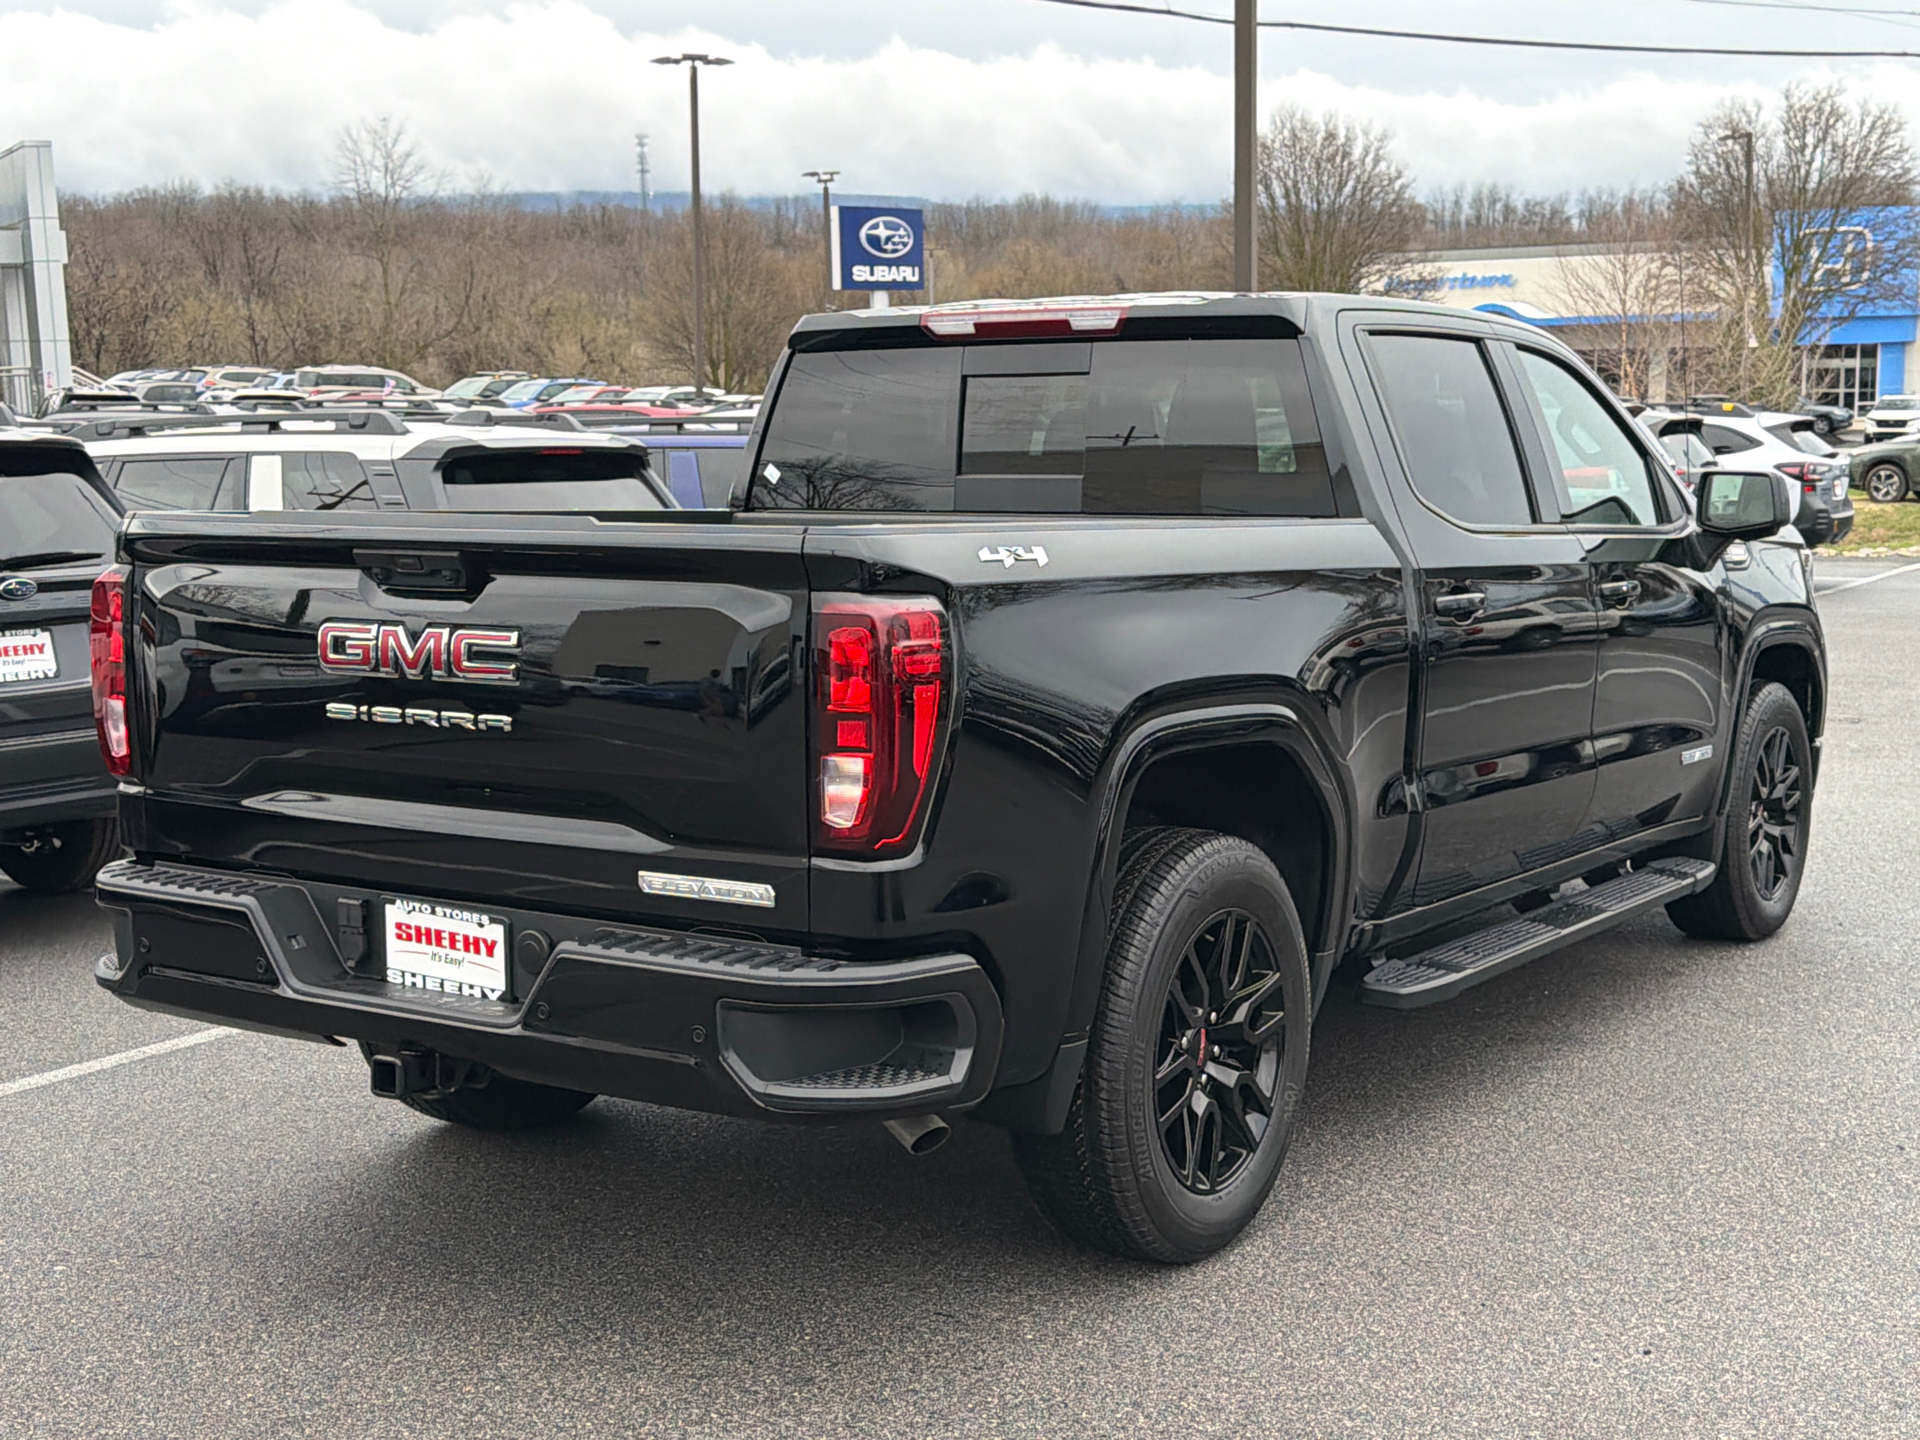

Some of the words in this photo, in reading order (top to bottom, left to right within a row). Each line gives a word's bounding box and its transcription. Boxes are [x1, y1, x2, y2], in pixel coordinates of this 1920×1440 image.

[852, 265, 919, 282] SUBARU
[0, 642, 46, 658] EEHY
[318, 620, 522, 686] GMC
[0, 668, 55, 682] EEHY
[325, 702, 513, 732] SIERRA
[642, 876, 770, 904] ELEVATION
[394, 898, 432, 915] AUTO
[434, 906, 491, 926] STORES
[394, 921, 498, 959] SHEEHY
[430, 950, 443, 963] It's
[444, 953, 466, 969] Easy!
[386, 968, 504, 1002] SHEEHY
[1130, 1034, 1155, 1183] BRIDGESTONE
